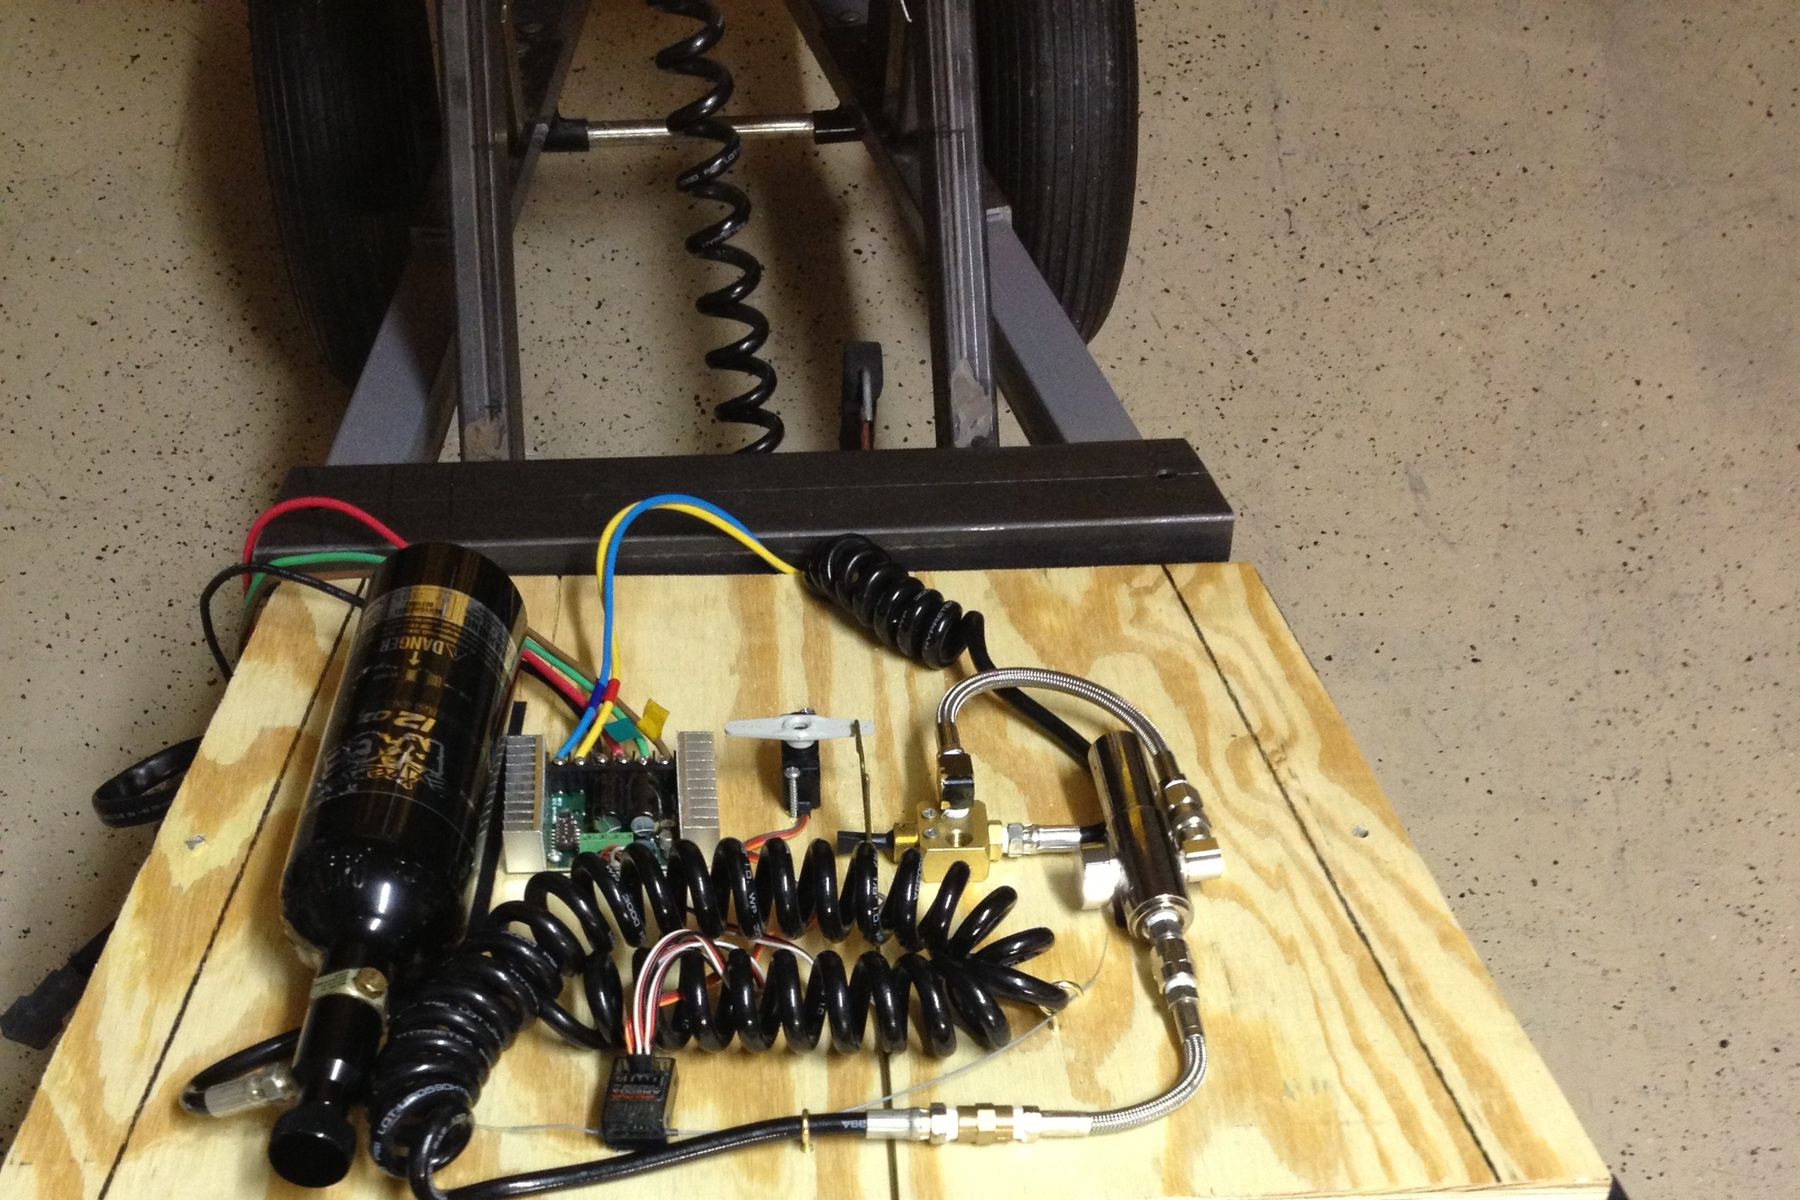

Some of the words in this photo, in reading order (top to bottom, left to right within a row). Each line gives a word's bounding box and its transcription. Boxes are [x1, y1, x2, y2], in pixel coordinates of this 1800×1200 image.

[379, 635, 445, 656] DANGER
[393, 710, 437, 732] 12
[621, 892, 640, 928] 3000
